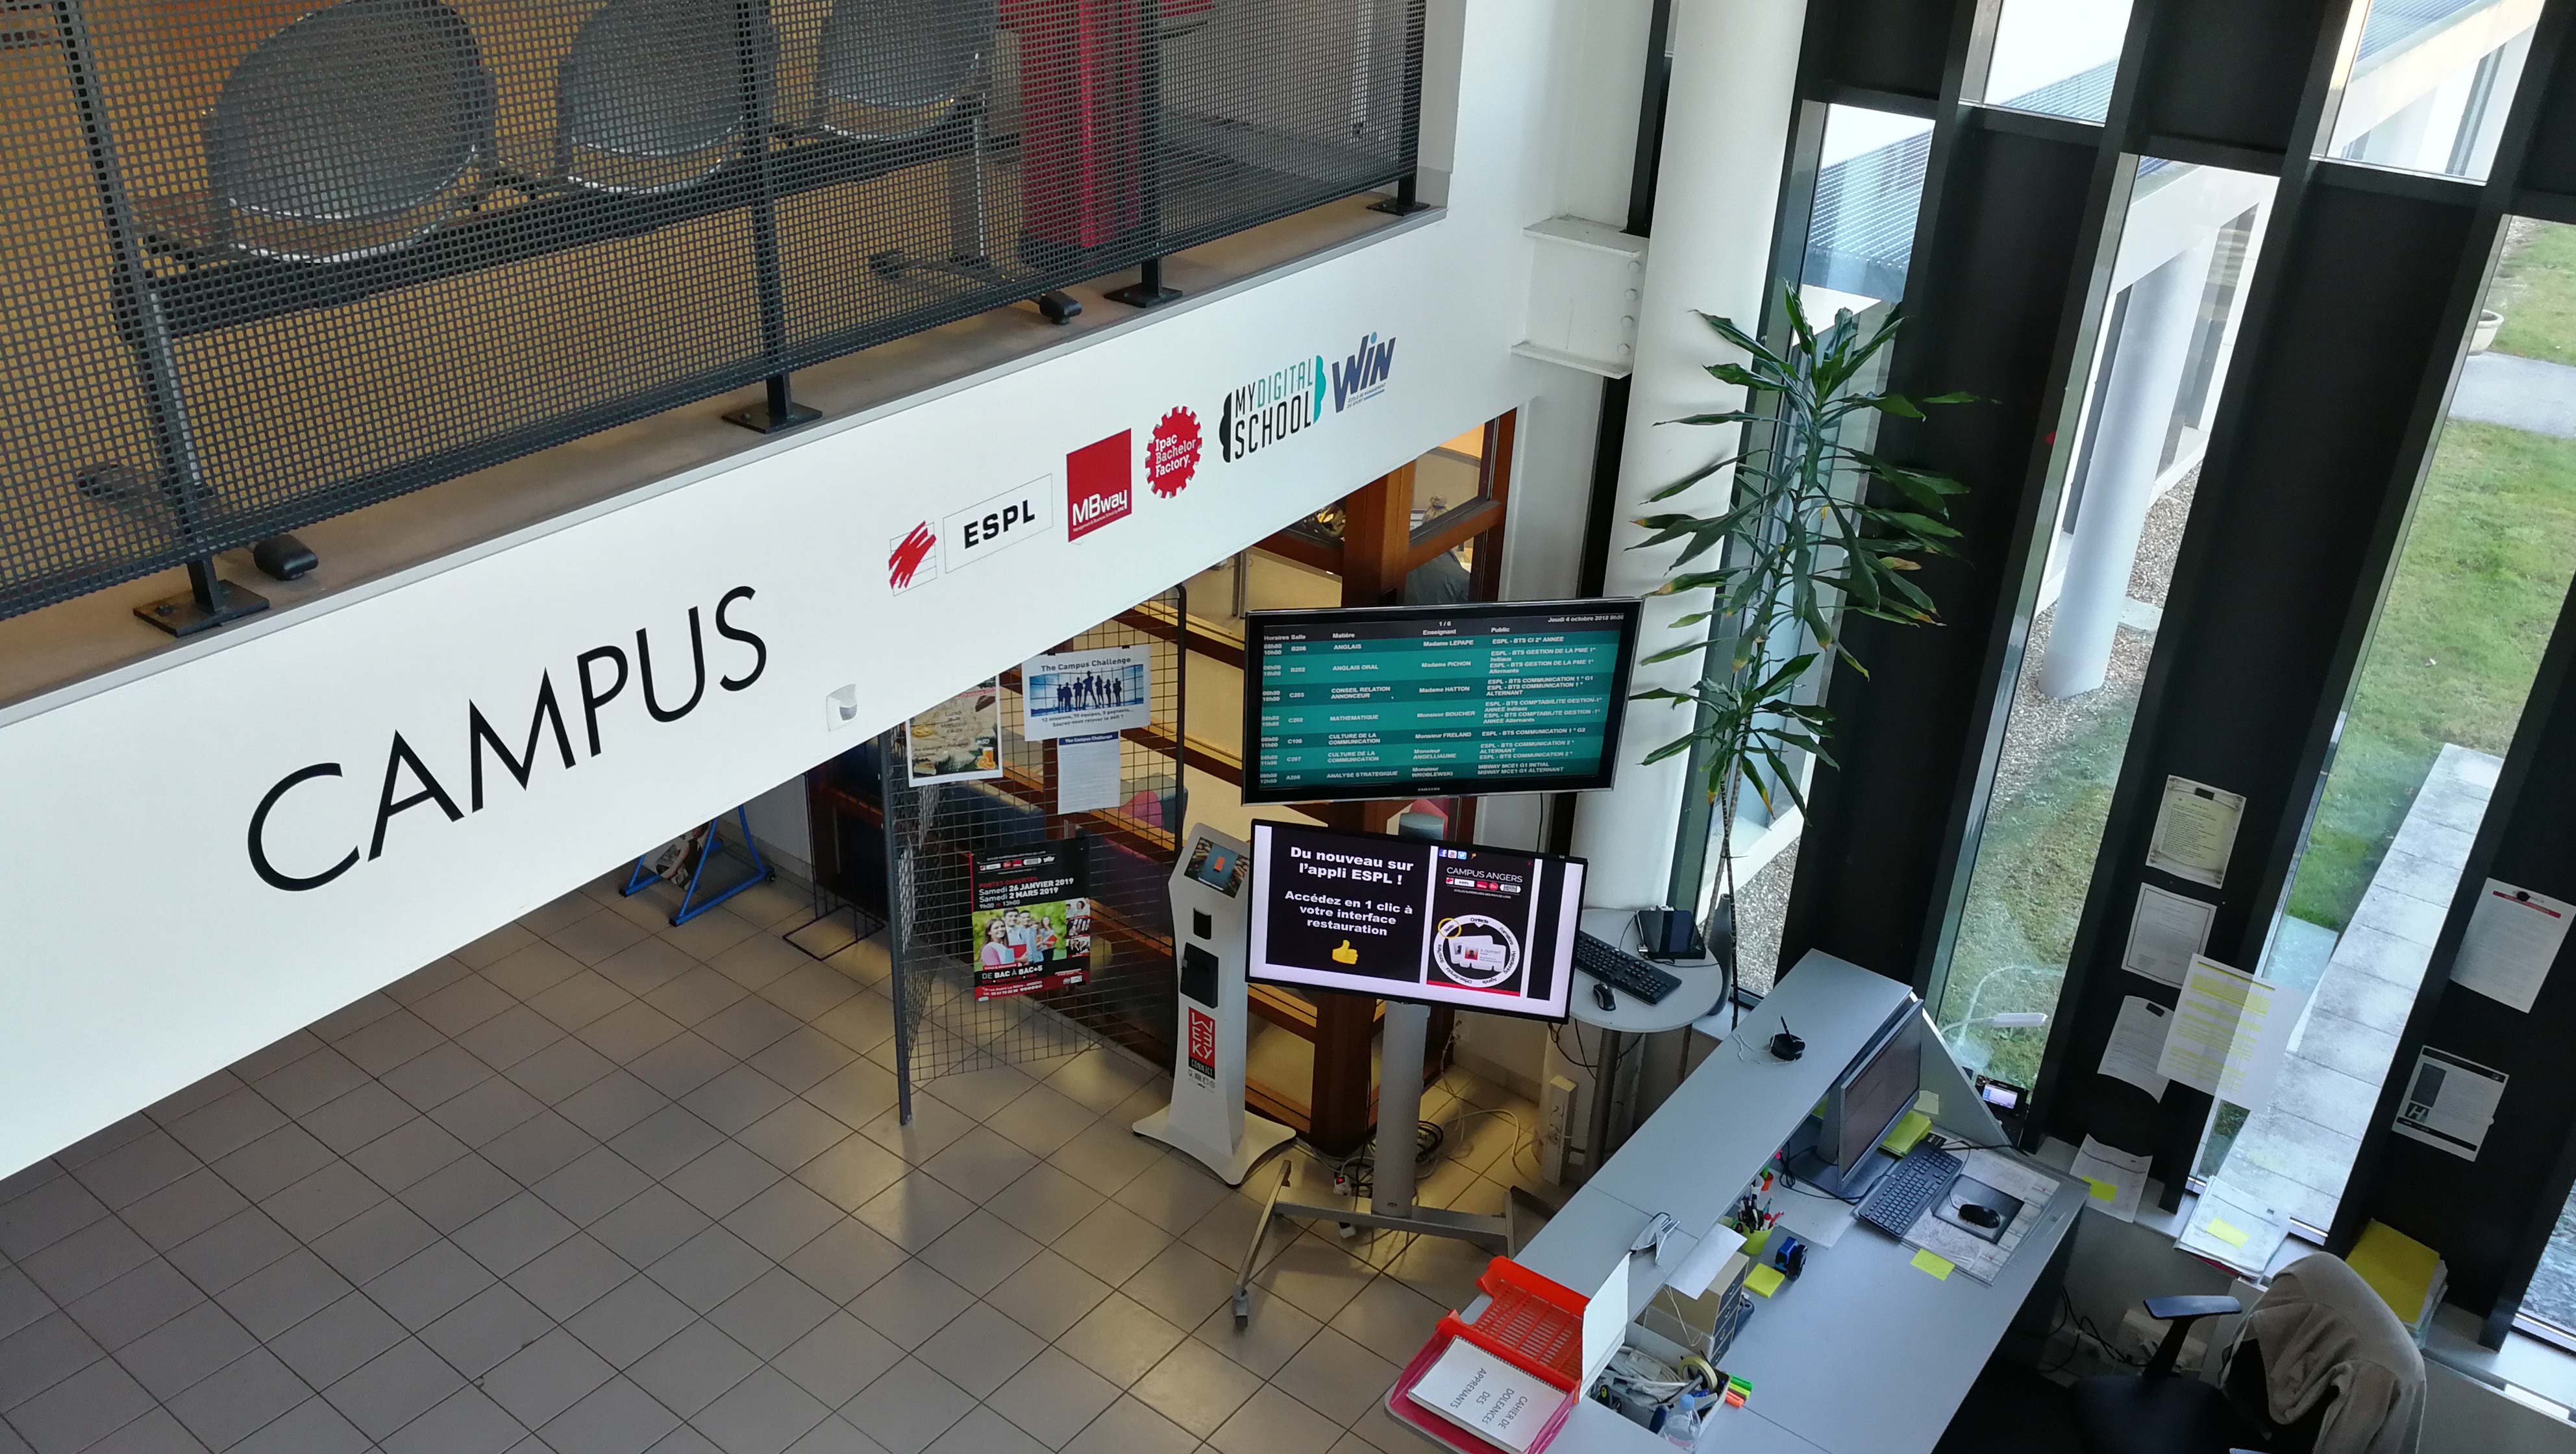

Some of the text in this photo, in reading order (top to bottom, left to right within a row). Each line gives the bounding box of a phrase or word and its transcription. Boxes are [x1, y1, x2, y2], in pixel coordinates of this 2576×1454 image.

[1235, 391, 1311, 459] SCHOOL
[1156, 435, 1177, 451] Ipac
[1156, 439, 1196, 464] Bachelor
[1073, 489, 1127, 526] MBway
[964, 499, 1035, 548] ESPL
[1058, 661, 1089, 671] Campus
[1092, 657, 1131, 666] Challenge
[247, 585, 767, 891] CAMPUS
[1291, 846, 1413, 871] Du nouveau sur
[1352, 869, 1393, 884] ESPL
[1446, 867, 1522, 882] CAMPUS ANGERS
[979, 887, 1008, 896] Samedi
[1020, 880, 1054, 891] JANVIER
[1055, 878, 1074, 886] 2019
[979, 894, 1008, 903] Samedi
[1016, 889, 1038, 898] MARS
[1285, 891, 1341, 906] Accédez
[1377, 902, 1400, 912] clic
[1404, 906, 1413, 915] à
[1300, 906, 1396, 924] votre interface
[1307, 919, 1387, 935] restauration
[1450, 1367, 1487, 1409] APPRENANTS
[1476, 1391, 1490, 1405] DES
[1482, 1388, 1515, 1425] DOLEANCES
[1498, 1396, 1528, 1429] CAHIER DE
